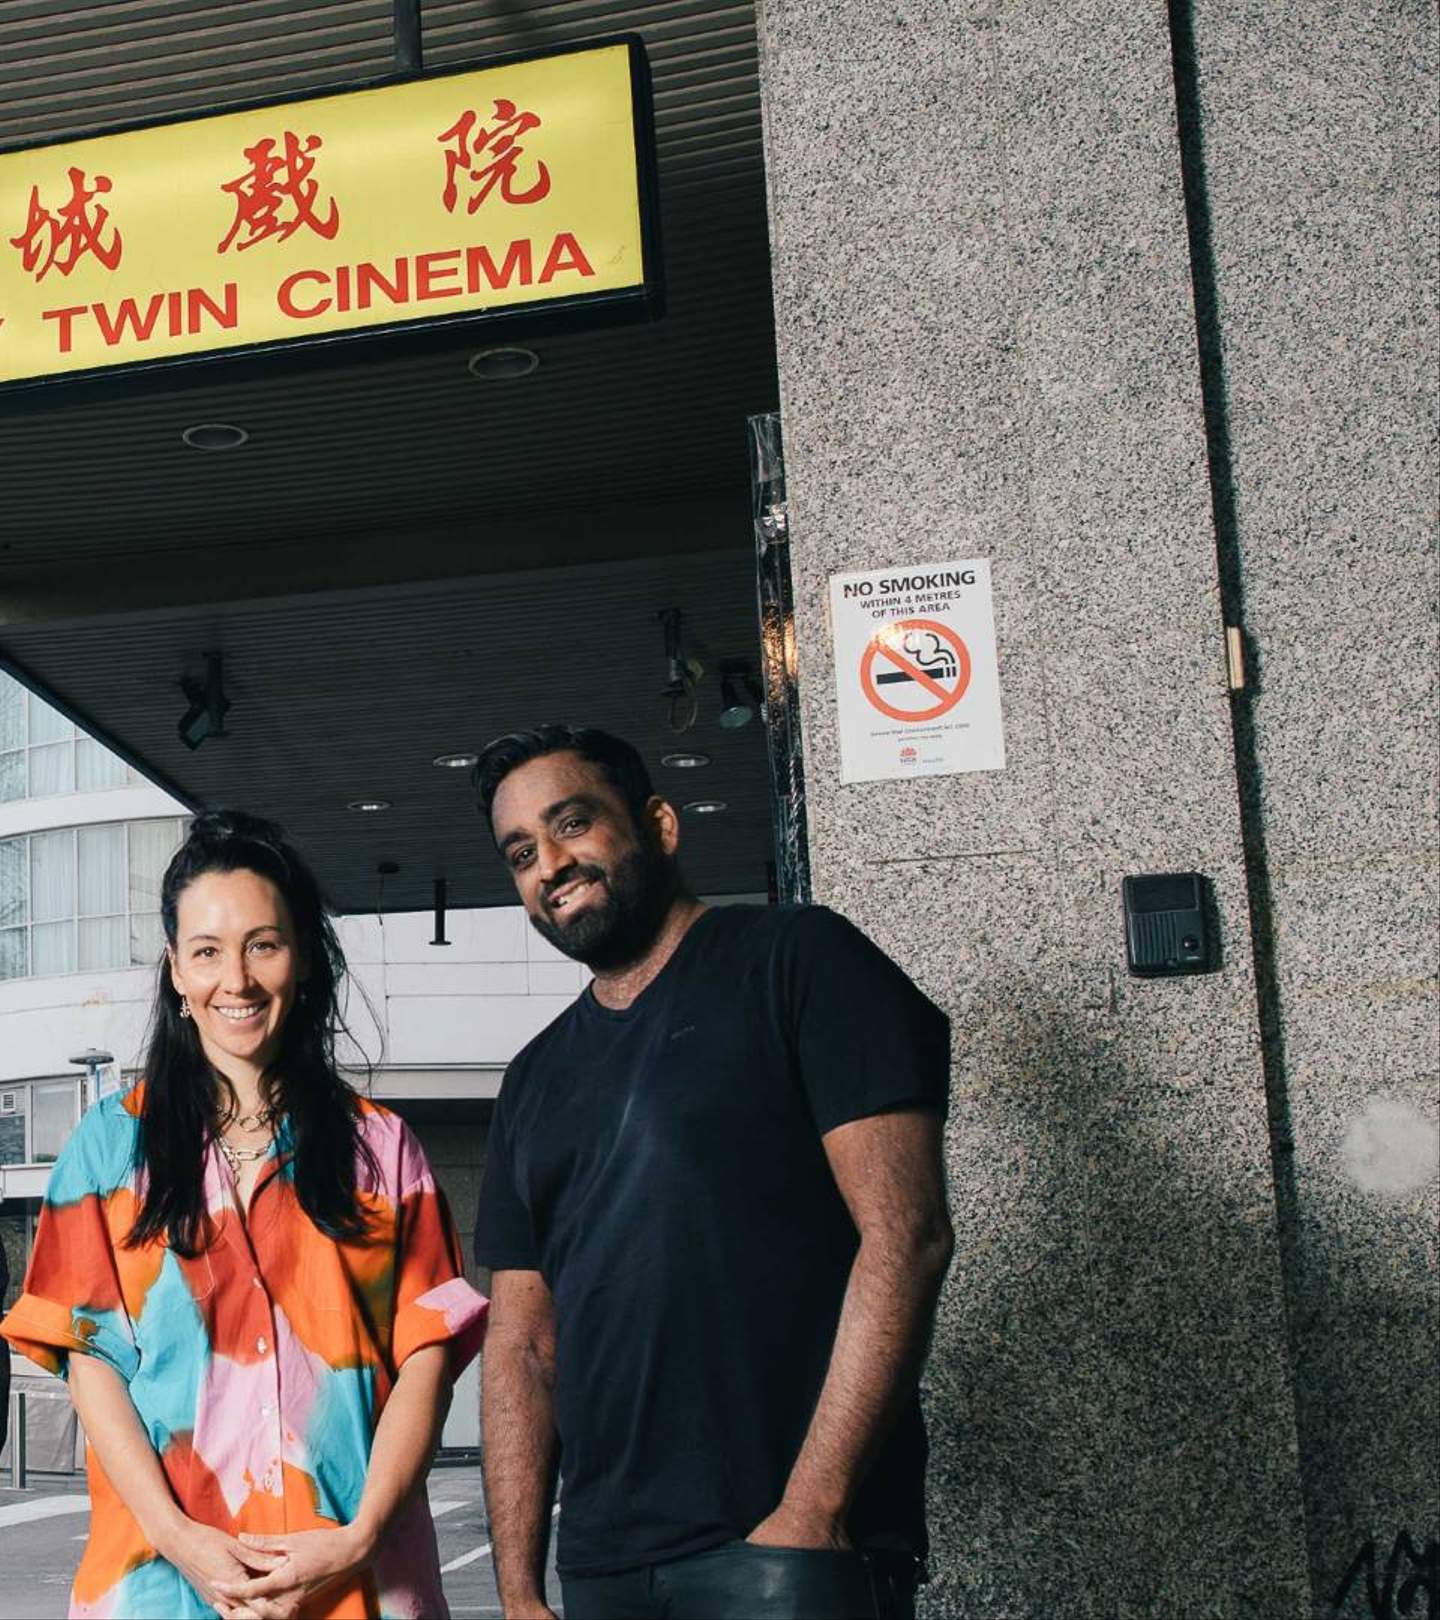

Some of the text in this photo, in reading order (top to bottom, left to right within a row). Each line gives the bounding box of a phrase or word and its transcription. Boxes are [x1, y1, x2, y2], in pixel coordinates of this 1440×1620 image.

[42, 282, 238, 353] TWIN
[277, 232, 594, 319] CINEMA
[843, 570, 976, 598] NO SMOKING
[860, 597, 901, 609] WITHIN
[915, 590, 961, 603] METRES
[872, 603, 951, 619] OF THIS AREA
